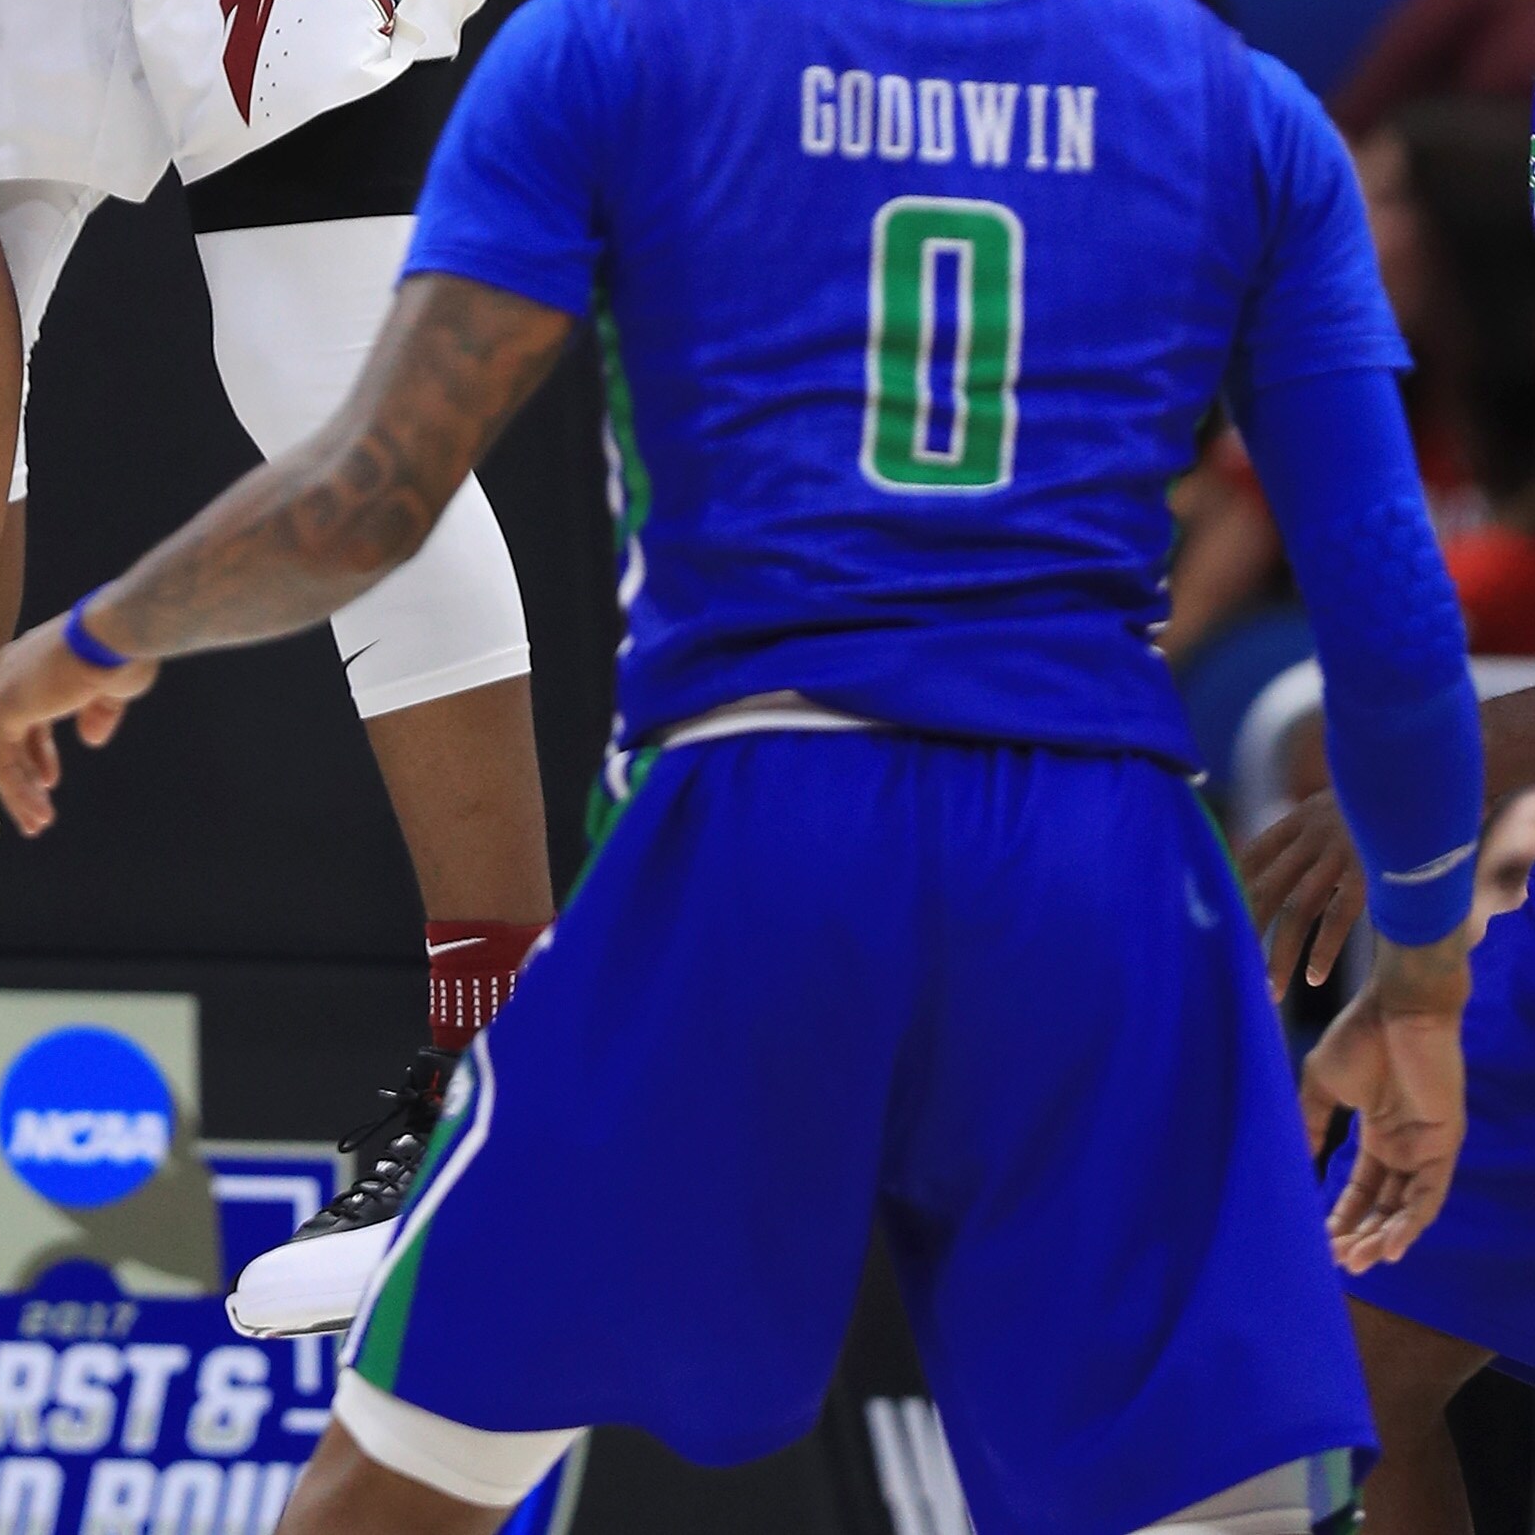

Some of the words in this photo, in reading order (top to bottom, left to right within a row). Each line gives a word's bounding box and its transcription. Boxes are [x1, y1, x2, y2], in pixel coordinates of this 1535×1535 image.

[800, 64, 1097, 173] GOODWIN
[860, 194, 1025, 497] 0
[9, 1110, 168, 1163] NCAA
[185, 1345, 272, 1457] &
